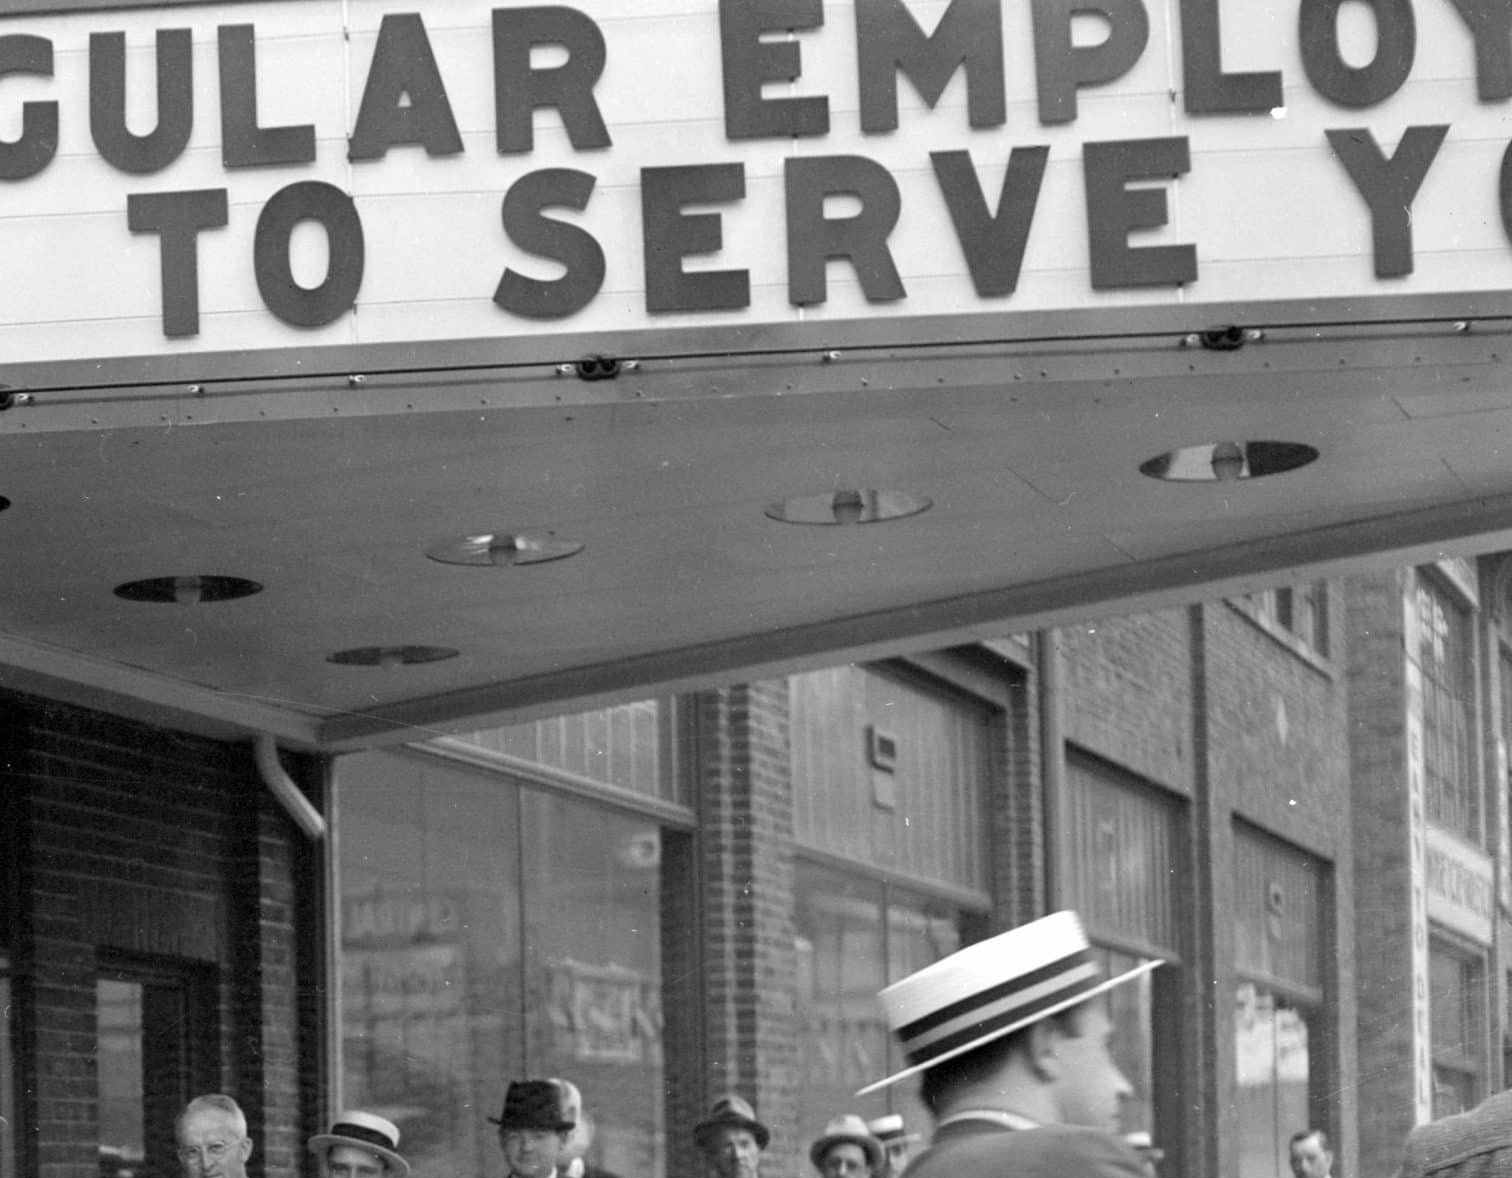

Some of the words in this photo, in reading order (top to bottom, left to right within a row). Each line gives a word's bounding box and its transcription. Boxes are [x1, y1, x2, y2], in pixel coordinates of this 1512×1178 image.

[126, 180, 365, 337] TO
[492, 135, 1199, 320] SERVE
[1323, 123, 1512, 280] Y
